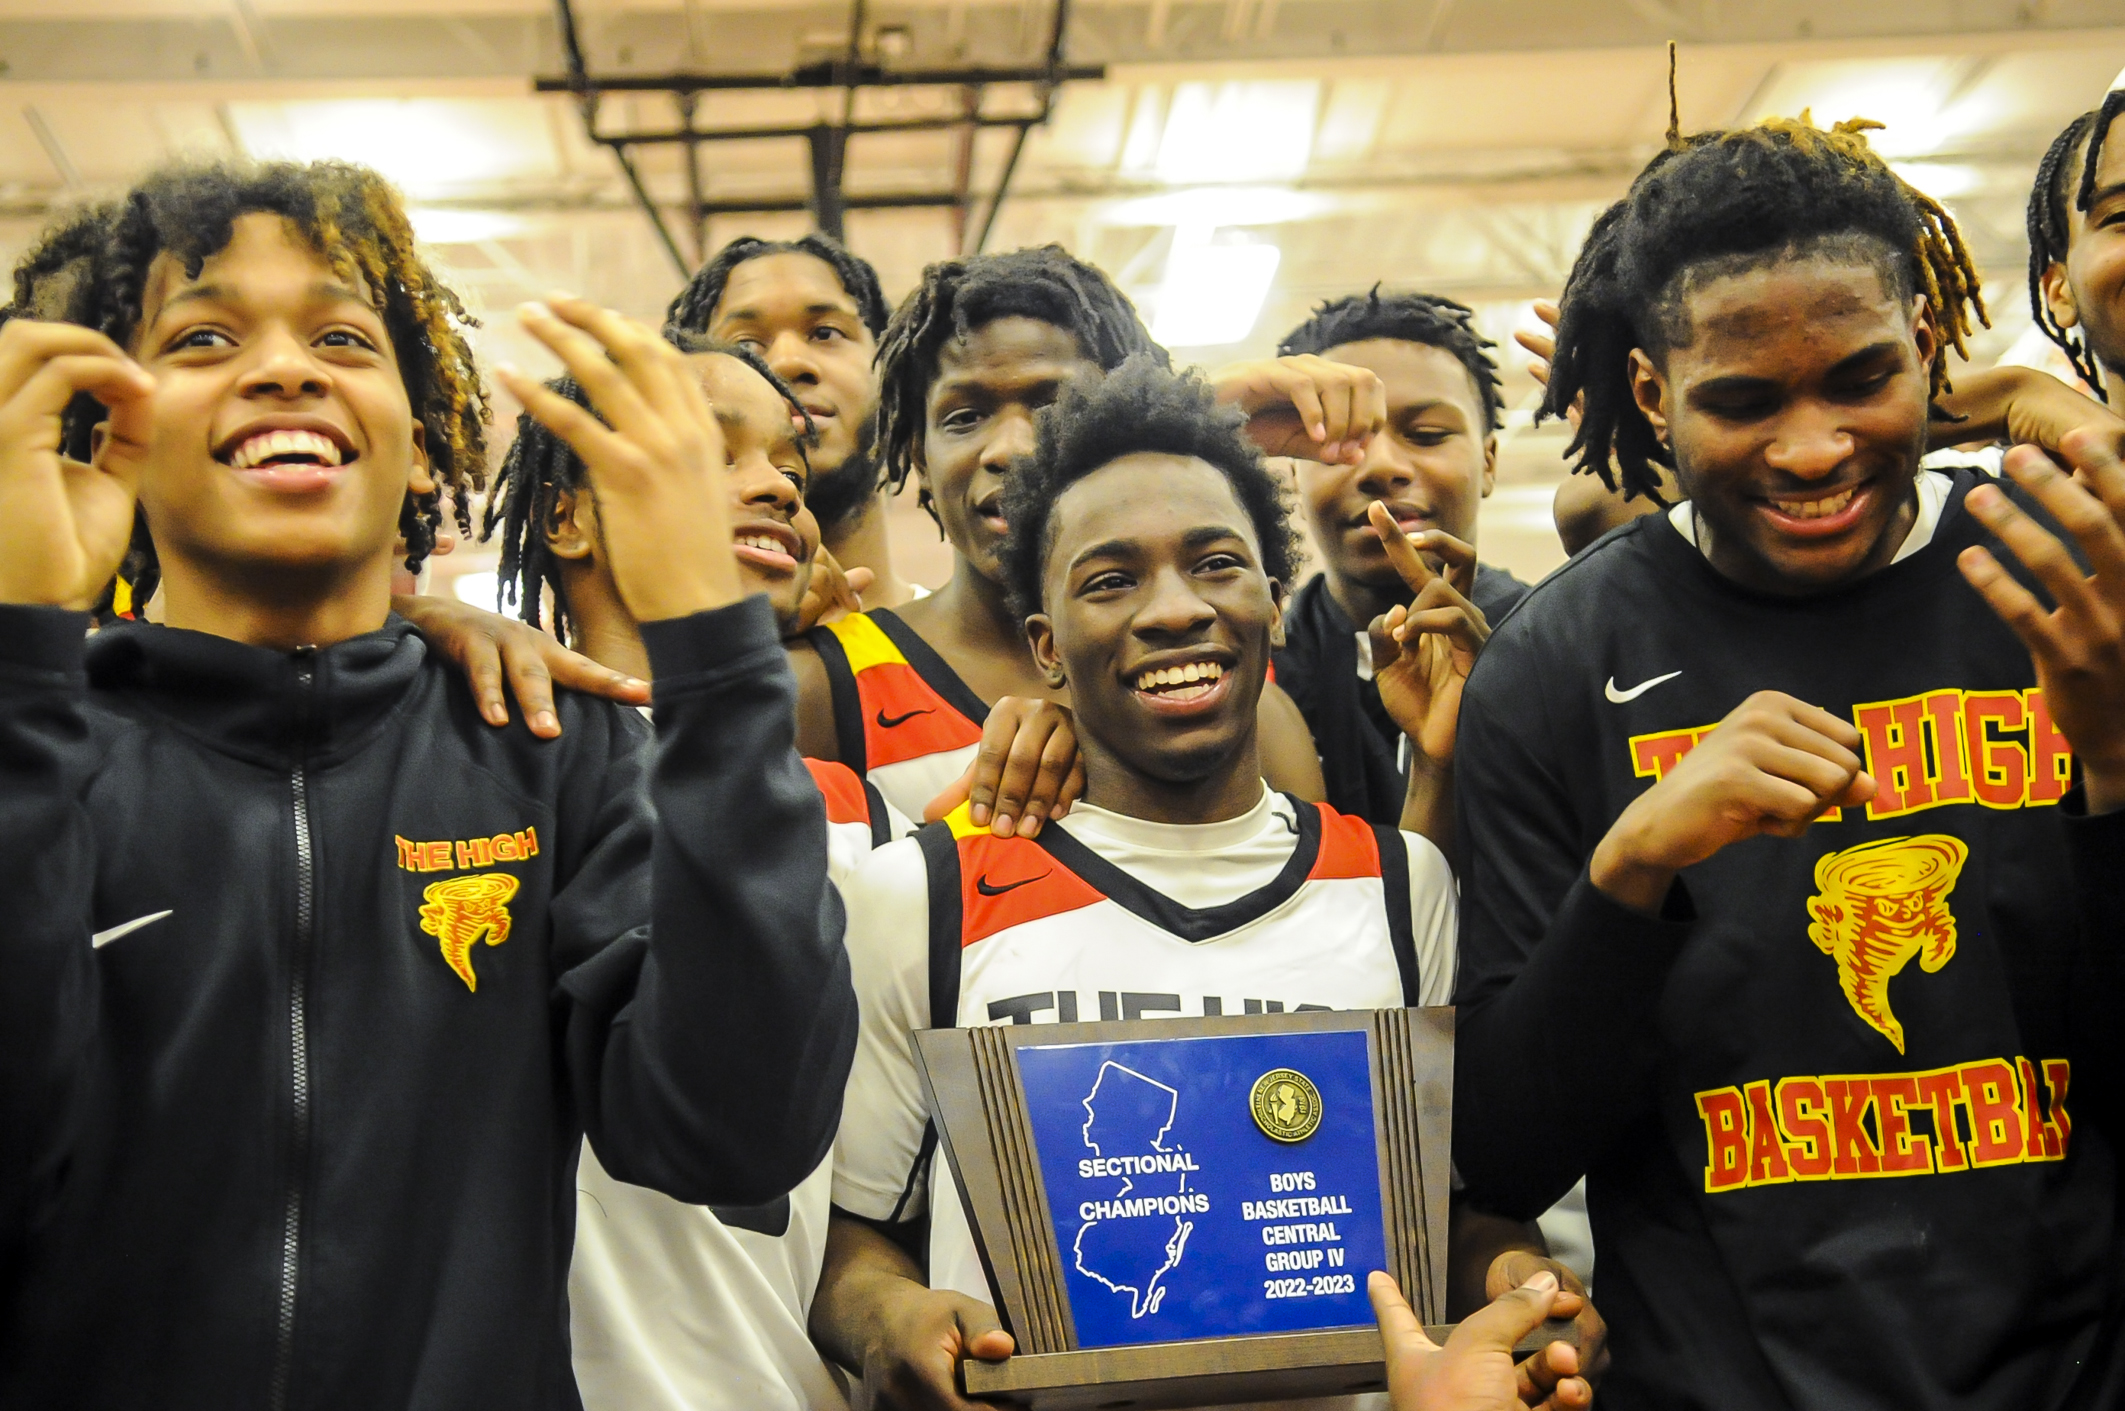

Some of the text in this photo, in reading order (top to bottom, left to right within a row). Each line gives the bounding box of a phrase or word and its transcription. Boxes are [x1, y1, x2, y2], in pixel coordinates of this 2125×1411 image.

[395, 826, 539, 872] THE HIGH
[1078, 1153, 1200, 1178] SECTIONAL
[1269, 1172, 1317, 1193] BOYS
[1079, 1194, 1210, 1221] CHAMPIONS
[1242, 1196, 1353, 1221] BASKETBALL
[1262, 1223, 1342, 1246] CENTRAL
[1265, 1248, 1345, 1272] GROUP IV
[1263, 1275, 1355, 1299] 2022-2023
